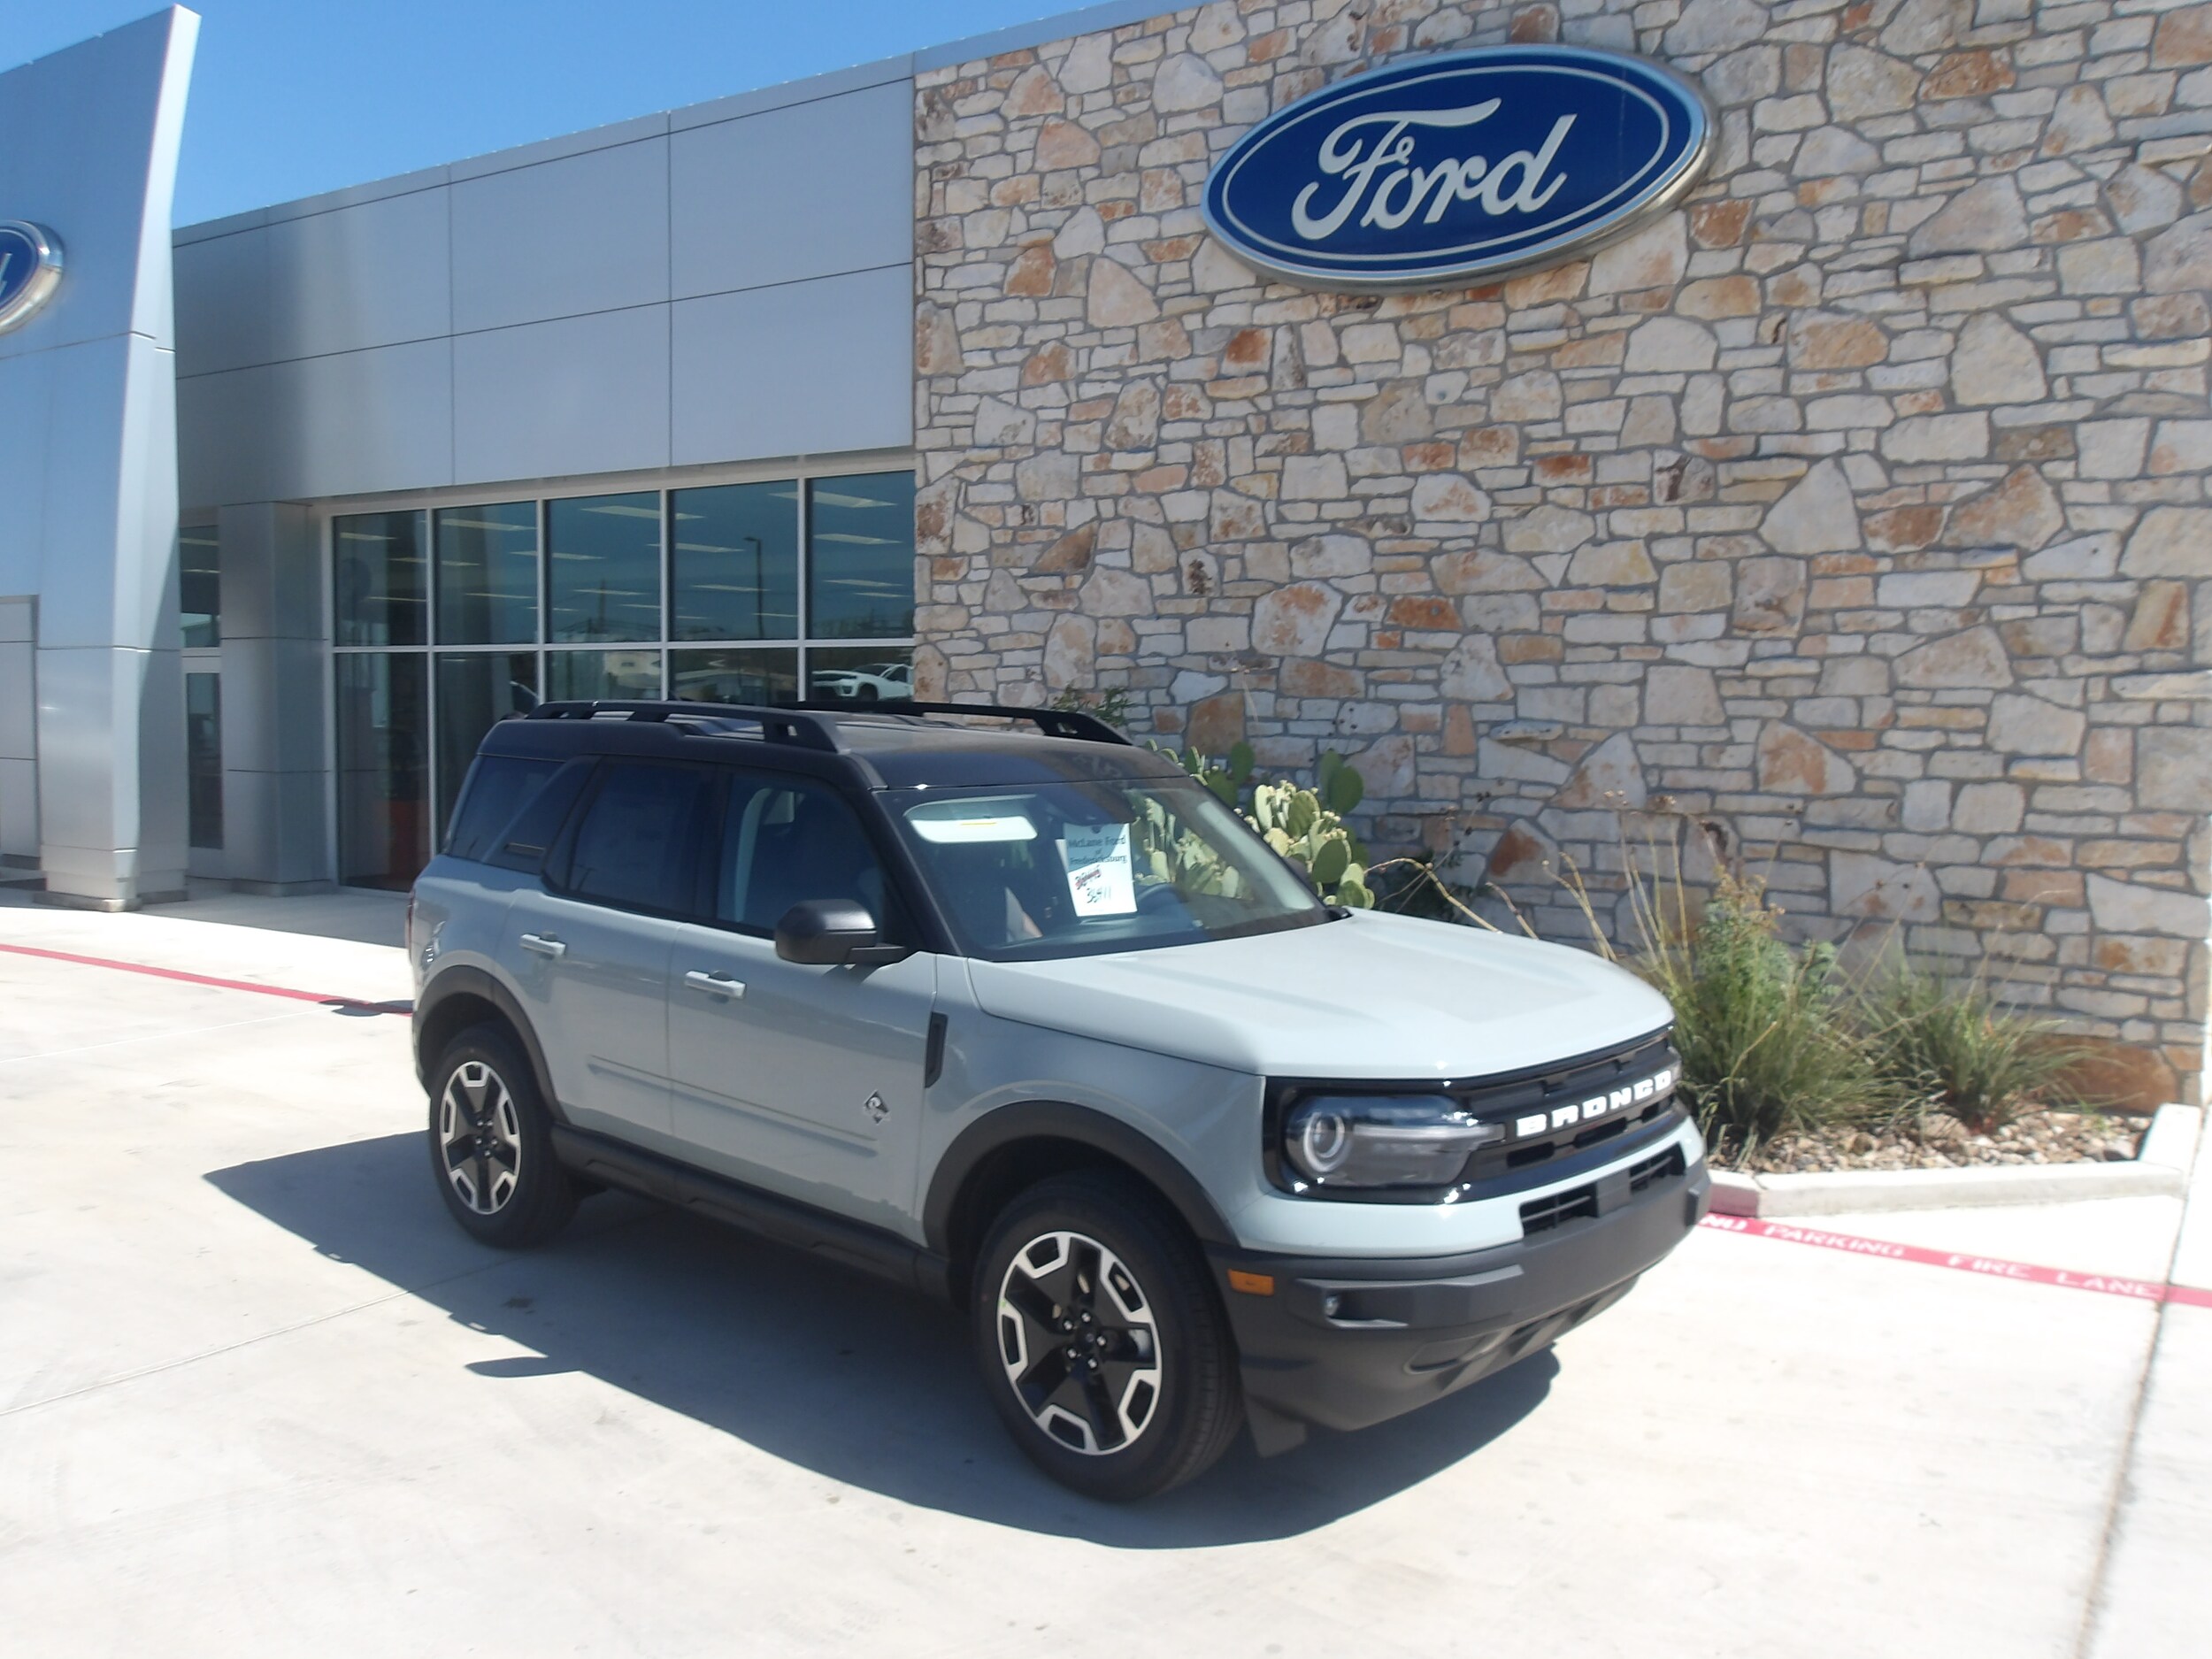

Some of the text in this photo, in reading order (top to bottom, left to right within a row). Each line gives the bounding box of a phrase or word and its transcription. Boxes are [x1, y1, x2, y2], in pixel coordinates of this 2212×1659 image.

[1291, 97, 1578, 240] Ford
[1516, 1070, 1672, 1137] BRONCO
[1699, 1215, 2164, 1298] NO PARKING FIRE LANE
